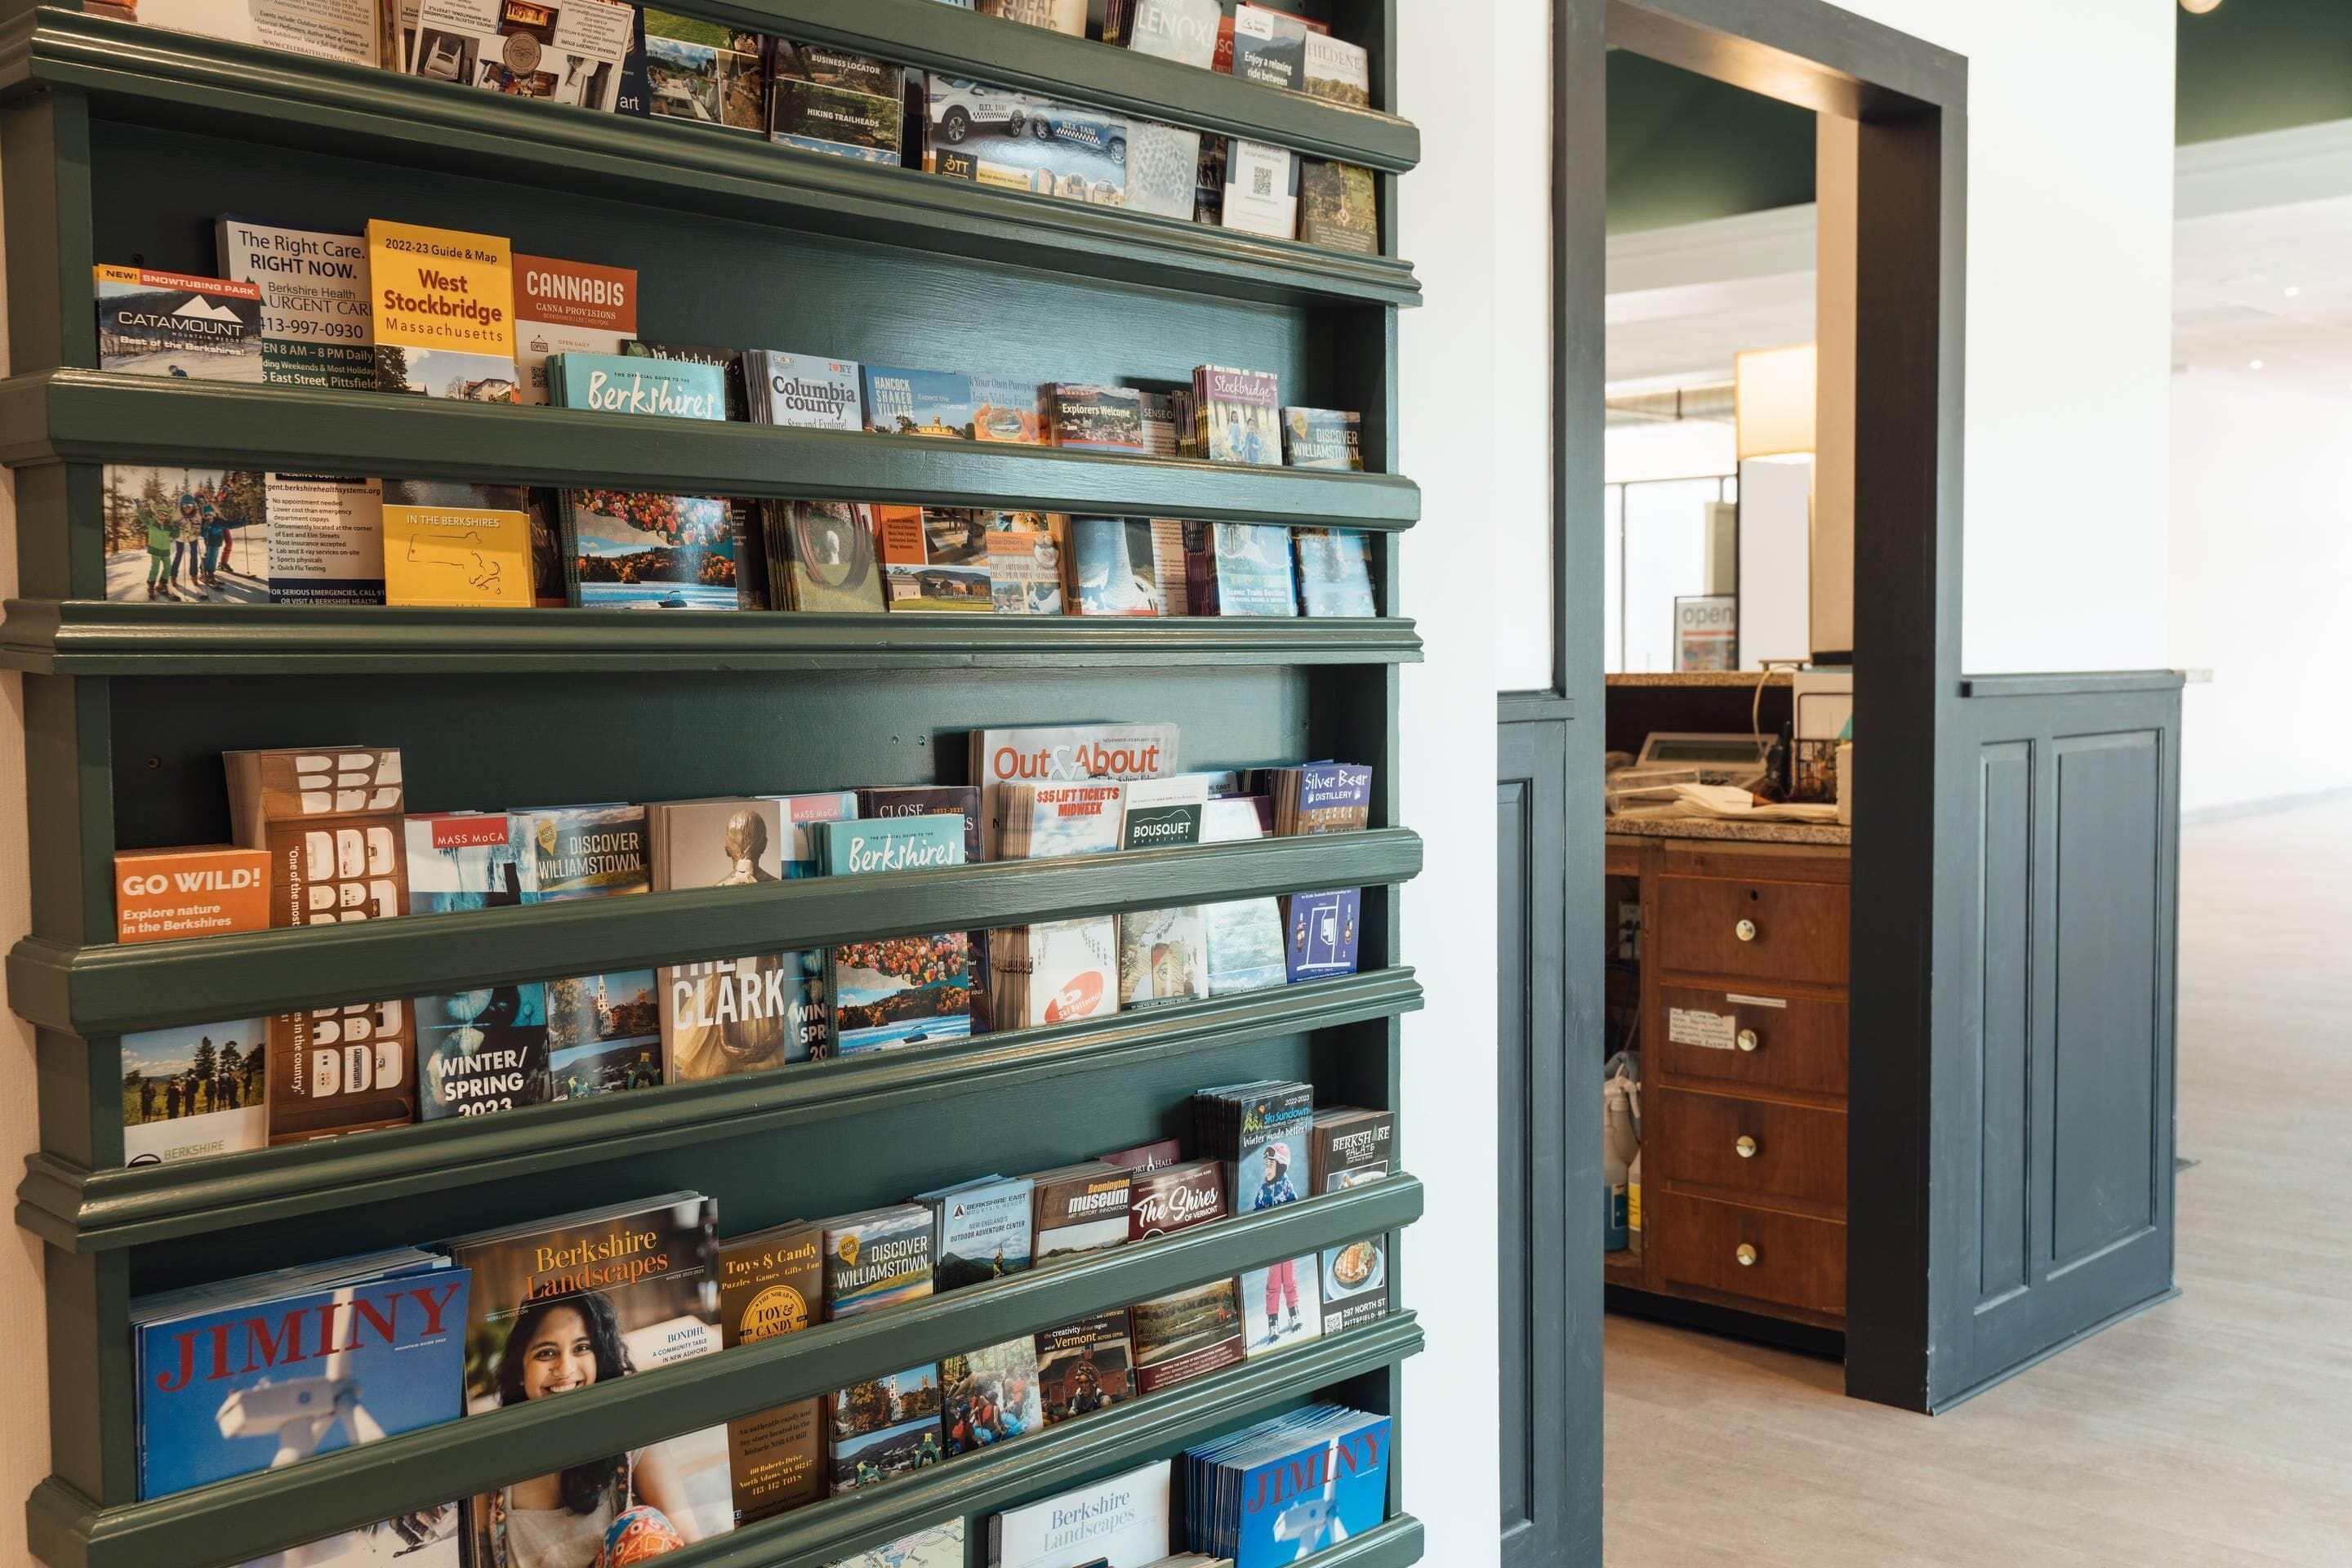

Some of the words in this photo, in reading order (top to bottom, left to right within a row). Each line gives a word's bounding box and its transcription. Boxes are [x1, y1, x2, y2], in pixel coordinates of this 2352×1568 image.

[260, 11, 276, 19] Events
[297, 19, 318, 28] Outdoor
[318, 24, 340, 34] Activities,
[342, 29, 363, 38] Speakers,
[576, 43, 596, 51] CONCEPT
[597, 47, 617, 55] PASSAGE
[812, 54, 846, 68] BUSINESS
[847, 60, 880, 74] LOCATOR
[1245, 51, 1262, 67] Enjoy
[1264, 58, 1268, 67] a
[1269, 59, 1292, 75] relaxing
[1248, 68, 1261, 79] ride
[1262, 71, 1288, 86] between
[620, 95, 639, 110] art
[808, 108, 834, 120] HIKING
[835, 113, 880, 127] TRAILHEADS
[238, 230, 270, 249] The
[274, 235, 318, 256] Right
[323, 241, 365, 259] Care.
[385, 238, 429, 254] 2022-23
[432, 245, 462, 259] Guide
[465, 250, 473, 260] &
[475, 251, 497, 265] Map
[251, 253, 301, 274] RIGHT
[309, 261, 357, 279] NOW.
[106, 270, 137, 280] NEW!
[142, 274, 221, 292] SNOWTUBING
[225, 285, 254, 296] PARK
[417, 269, 467, 293] West
[526, 270, 625, 307] CANNABIS
[269, 282, 318, 296] Berkshire
[322, 287, 355, 300] Health
[270, 295, 328, 314] URGENT
[384, 290, 502, 327] Stockbridge
[536, 302, 564, 314] CANNA
[566, 306, 616, 320] PROVISIONS
[118, 311, 243, 336] CATAMOUNT
[386, 317, 503, 341] Massachusetts
[120, 336, 148, 347] Best
[149, 339, 162, 348] of
[164, 340, 183, 350] the
[185, 342, 244, 356] Berkshires!
[270, 372, 292, 383] East
[295, 374, 328, 387] Street,
[874, 376, 911, 393] HANCOCK
[973, 377, 991, 388] Your
[991, 379, 1008, 389] Own
[1008, 381, 1041, 393] Pumpkins
[588, 371, 715, 418] Berkshires
[772, 376, 857, 403] Columbia
[875, 390, 912, 404] SHAKER
[1214, 375, 1271, 405] Stockbridge
[786, 397, 844, 421] county
[877, 403, 915, 418] VILLAGE
[1062, 403, 1099, 416] Explorers
[1100, 406, 1130, 418] Welcome
[1316, 428, 1358, 444] DISCOVER
[1293, 443, 1359, 460] WILLIAMSTOWN
[407, 514, 417, 524] IN
[421, 515, 439, 525] THE
[441, 516, 500, 528] BERKSHIRES
[1682, 607, 1735, 627] open
[994, 746, 1051, 779] Out
[1075, 742, 1160, 774] About
[1305, 772, 1335, 791] Silver
[1339, 769, 1368, 787] Bear
[1037, 789, 1055, 804] $35
[1056, 789, 1077, 802] LIFT
[1078, 787, 1119, 800] TICKETS
[1316, 791, 1352, 802] DISTILLERY
[1058, 802, 1102, 817] MIDWEEK
[438, 834, 468, 845] MASS
[473, 832, 505, 844] MoCA
[1134, 822, 1191, 838] BOUSQUET
[570, 832, 639, 854] DISCOVER
[849, 834, 955, 874] Berkshires
[539, 853, 640, 880] WILLIAMSTOWN
[123, 874, 168, 897] GO
[174, 867, 261, 892] WILD!
[290, 872, 301, 882] of
[291, 883, 301, 899] the
[123, 906, 175, 921] Explore
[177, 904, 221, 916] nature
[292, 902, 301, 926] most
[123, 922, 136, 934] in
[138, 921, 161, 933] the
[163, 916, 232, 931] Berkshires
[672, 968, 785, 1031] CLARK
[1058, 1005, 1069, 1019] Ski
[439, 1046, 528, 1077] WINTER/
[444, 1073, 524, 1101] SPRING
[1264, 1113, 1274, 1124] Ski
[1275, 1107, 1309, 1120] Sundown
[1243, 1135, 1266, 1147] Winter
[1267, 1131, 1284, 1141] made
[1285, 1123, 1308, 1137] better!
[164, 1140, 225, 1160] BERKSHIRE
[1346, 1144, 1374, 1157] PALATE
[1088, 1178, 1130, 1192] Bennington
[966, 1197, 1006, 1211] BERKSHIRE
[1008, 1192, 1027, 1204] EAST
[1068, 1188, 1129, 1214] museum
[1132, 1194, 1166, 1228] The
[1173, 1185, 1218, 1222] Shires
[1192, 1205, 1218, 1219] VERMONT
[950, 1232, 975, 1243] OUTDOOR
[976, 1225, 1005, 1237] ADVENTURE
[1006, 1220, 1025, 1230] CENTER
[536, 1231, 657, 1273] Berkshire
[726, 1259, 760, 1276] Toys
[763, 1254, 774, 1269] &
[777, 1242, 817, 1264] Candy
[871, 1236, 928, 1263] DISCOVER
[525, 1253, 668, 1300] Landscapes
[837, 1254, 928, 1289] WILLIAMSTOWN
[756, 1305, 782, 1322] TOY
[783, 1304, 794, 1316] &
[1343, 1307, 1354, 1317] 297
[1355, 1302, 1376, 1313] NORTH
[1377, 1298, 1386, 1307] ST
[756, 1318, 793, 1337] CANDY
[1344, 1313, 1375, 1327] PITTSFIELD
[156, 1281, 463, 1392] JIMINY
[667, 1326, 706, 1343] BONDHU
[1052, 1326, 1080, 1339] creativity
[1055, 1333, 1096, 1348] Vermont
[658, 1343, 692, 1356] COMMUNITY
[693, 1339, 707, 1348] TABLE
[670, 1352, 683, 1362] NEW
[684, 1347, 708, 1360] ASHFORD
[760, 1461, 784, 1472] Roberts
[786, 1455, 803, 1463] Drive
[1247, 1428, 1387, 1513] JIMINY
[1051, 1490, 1131, 1530] Berkshire
[1043, 1507, 1135, 1552] Landscapes
